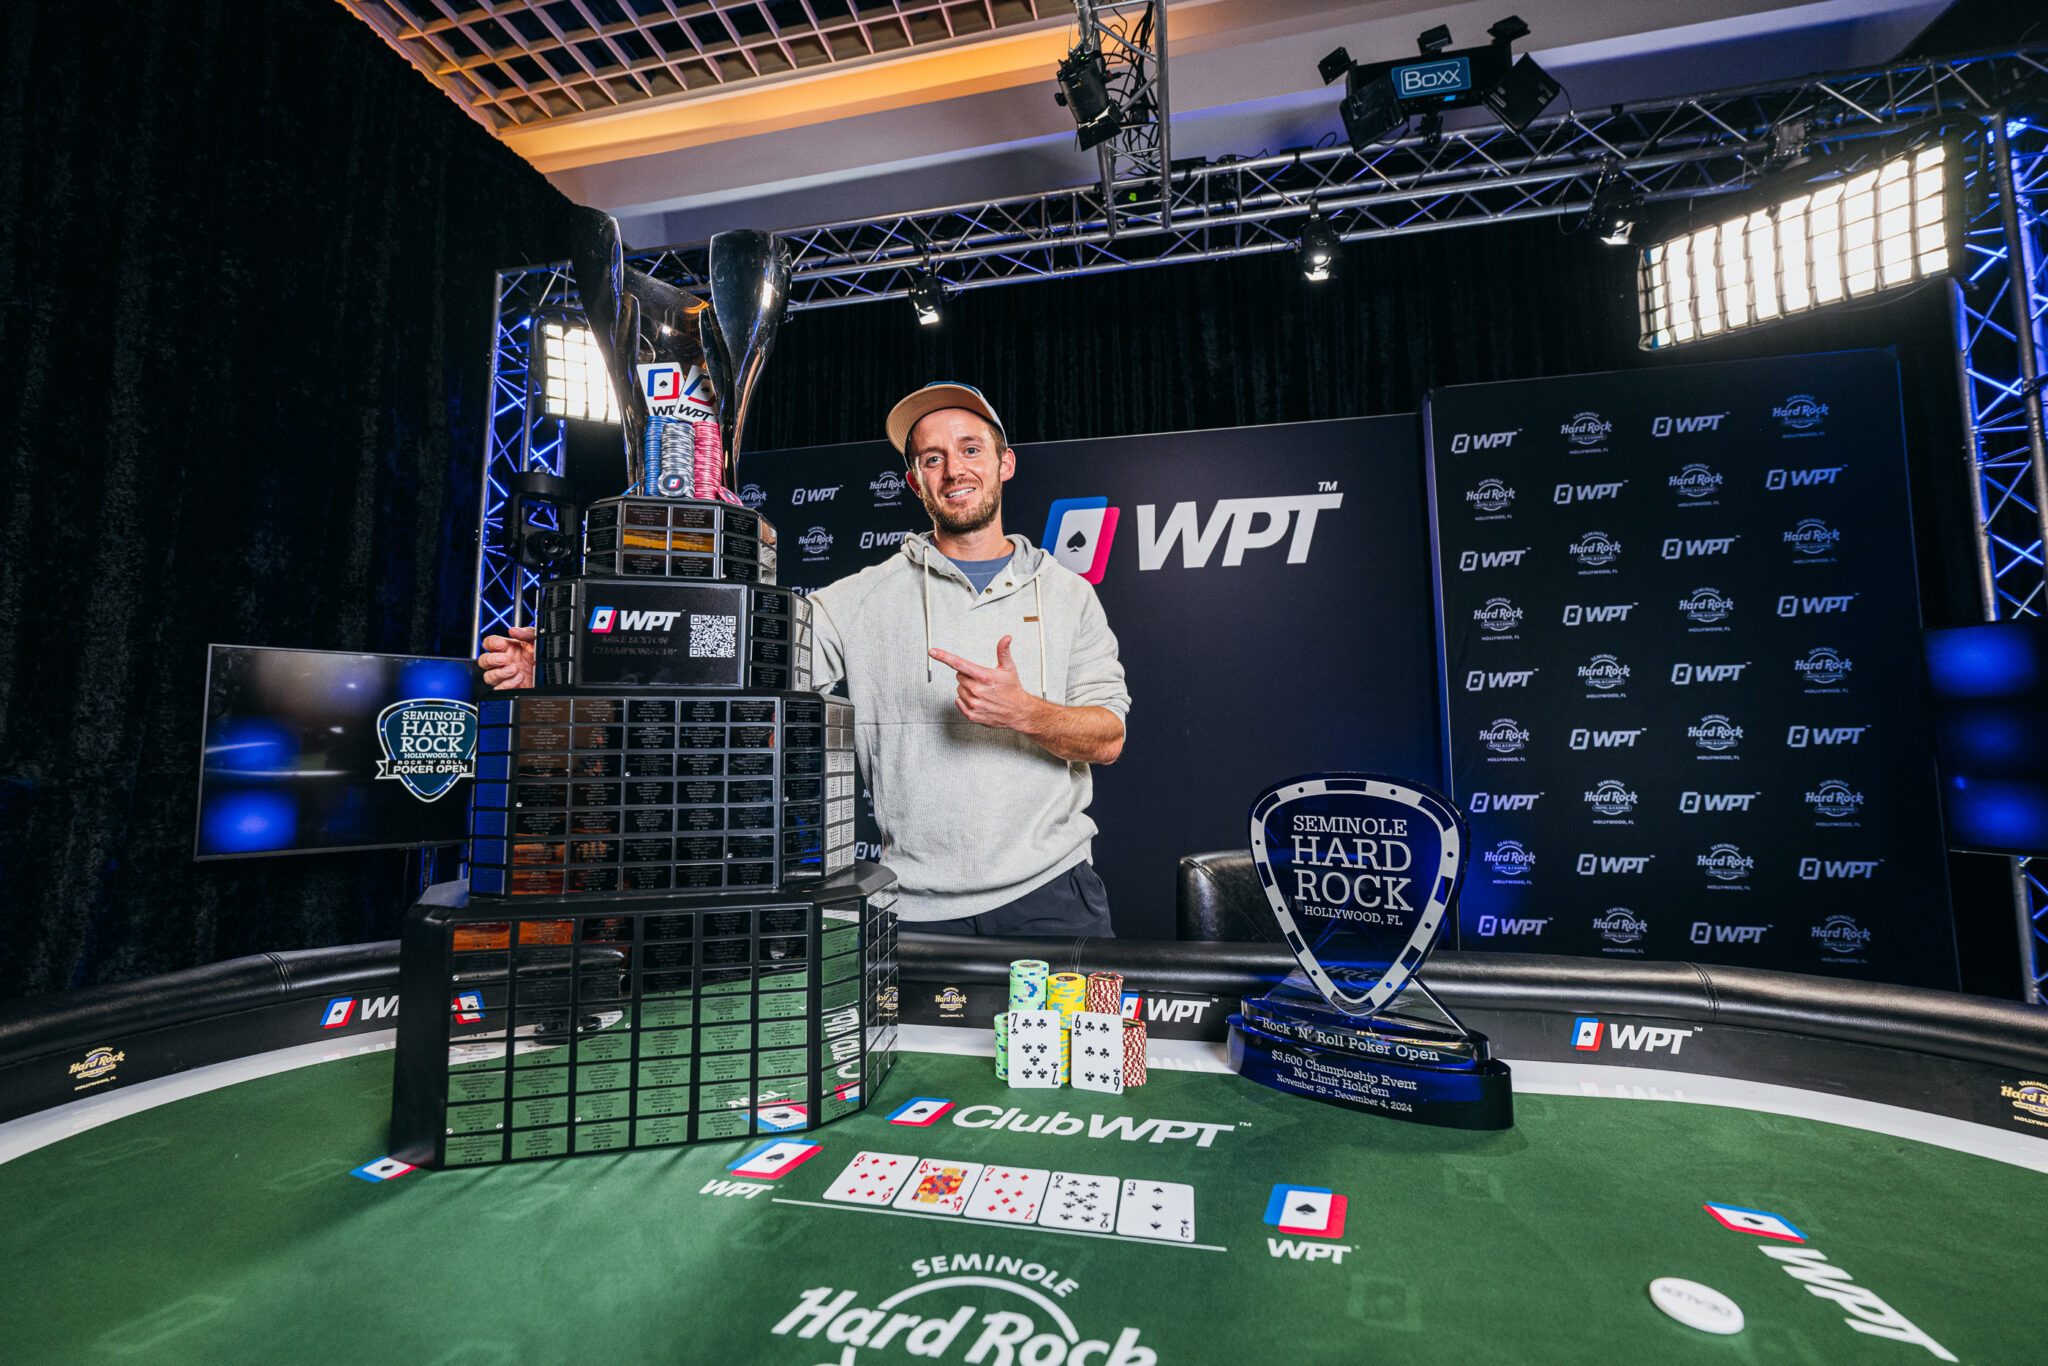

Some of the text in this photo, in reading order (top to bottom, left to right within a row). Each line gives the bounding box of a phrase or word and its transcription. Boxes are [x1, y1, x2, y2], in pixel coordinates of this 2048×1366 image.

[1405, 69, 1460, 90] Boxx
[652, 405, 676, 416] WP
[679, 404, 713, 421] WPT
[1772, 403, 1829, 417] Hard Rock
[1561, 421, 1612, 434] Hard Rock
[1676, 415, 1724, 433] WPT
[1474, 432, 1517, 449] WPT
[869, 479, 906, 490] Hard Rock
[1669, 473, 1723, 486] Hard Rock
[1791, 467, 1842, 486] WPT
[808, 487, 839, 502] WPT
[1466, 488, 1515, 501] Hard Rock
[1577, 483, 1623, 500] WPT
[1136, 481, 1344, 571] WPT TM
[798, 534, 833, 545] Hard Rock
[1783, 529, 1840, 542] Hard Rock
[1570, 541, 1621, 554] Hard Rock
[1686, 538, 1734, 556] WPT
[1482, 550, 1526, 567] WPT
[1679, 598, 1734, 611] Hard Rock
[1802, 596, 1854, 613] WPT
[620, 610, 681, 631] WPT
[1474, 608, 1523, 620] Hard Rock
[1586, 605, 1632, 622] WPT
[1578, 665, 1630, 677] Hard Rock
[1696, 665, 1745, 681] WPT
[1794, 659, 1852, 671] Hard Rock
[1489, 671, 1533, 688] WPT
[402, 711, 465, 721] SEMINOLE
[401, 721, 465, 736] HARD
[1480, 729, 1529, 741] Hard Rock
[1688, 726, 1743, 739] Hard Rock
[1813, 728, 1865, 744] WPT
[400, 737, 463, 752] ROCK
[1593, 731, 1641, 747] WPT
[393, 765, 467, 774] POKER OPEN
[1493, 795, 1539, 811] WPT
[1585, 791, 1638, 804] Hard Rock
[1704, 795, 1755, 811] WPT
[1805, 792, 1864, 805] Hard Rock
[1293, 815, 1407, 836] SEMINOLE
[1291, 835, 1412, 872] HARD
[1485, 851, 1536, 864] Hard Rock
[1601, 857, 1649, 873] WPT
[1697, 855, 1754, 869] Hard Rock
[1825, 861, 1878, 878] WPT
[1294, 869, 1414, 912] ROCK
[1304, 906, 1403, 925] HOLLYWOOD, FL
[1501, 918, 1547, 935] WPT
[1593, 919, 1648, 932] Hard Rock
[1715, 926, 1767, 943] WPT
[1811, 927, 1870, 942] Hard Rock
[1147, 998, 1211, 1024] WPT
[1011, 1013, 1018, 1028] 7
[1074, 1014, 1081, 1029] 6
[1262, 1017, 1291, 1036] Rock
[1317, 1031, 1345, 1048] Roll
[1349, 1037, 1391, 1055] Poker
[1395, 1045, 1440, 1061] Open
[1610, 1023, 1693, 1055] WPT
[69, 1057, 98, 1074] Hard
[98, 1050, 126, 1066] Rock
[1271, 1049, 1417, 1091] $3,500 Champioship Event
[1293, 1067, 1309, 1080] No
[1310, 1072, 1340, 1088] Limit
[2018, 1080, 2048, 1090] SEMINO
[1276, 1074, 1315, 1092] November
[1334, 1089, 1378, 1107] December
[1390, 1101, 1413, 1113] 2024
[2000, 1085, 2039, 1103] Hard
[952, 1105, 1235, 1148] ClubWPT
[857, 1154, 867, 1163] 6
[920, 1161, 932, 1170] K
[699, 1179, 775, 1199] WPT
[1128, 1182, 1137, 1191] 3
[1267, 1237, 1352, 1264] WPT
[911, 1253, 1080, 1298] SEMINOLE
[1757, 1245, 1960, 1363] WPT
[771, 1287, 1158, 1366] Hard Rock
